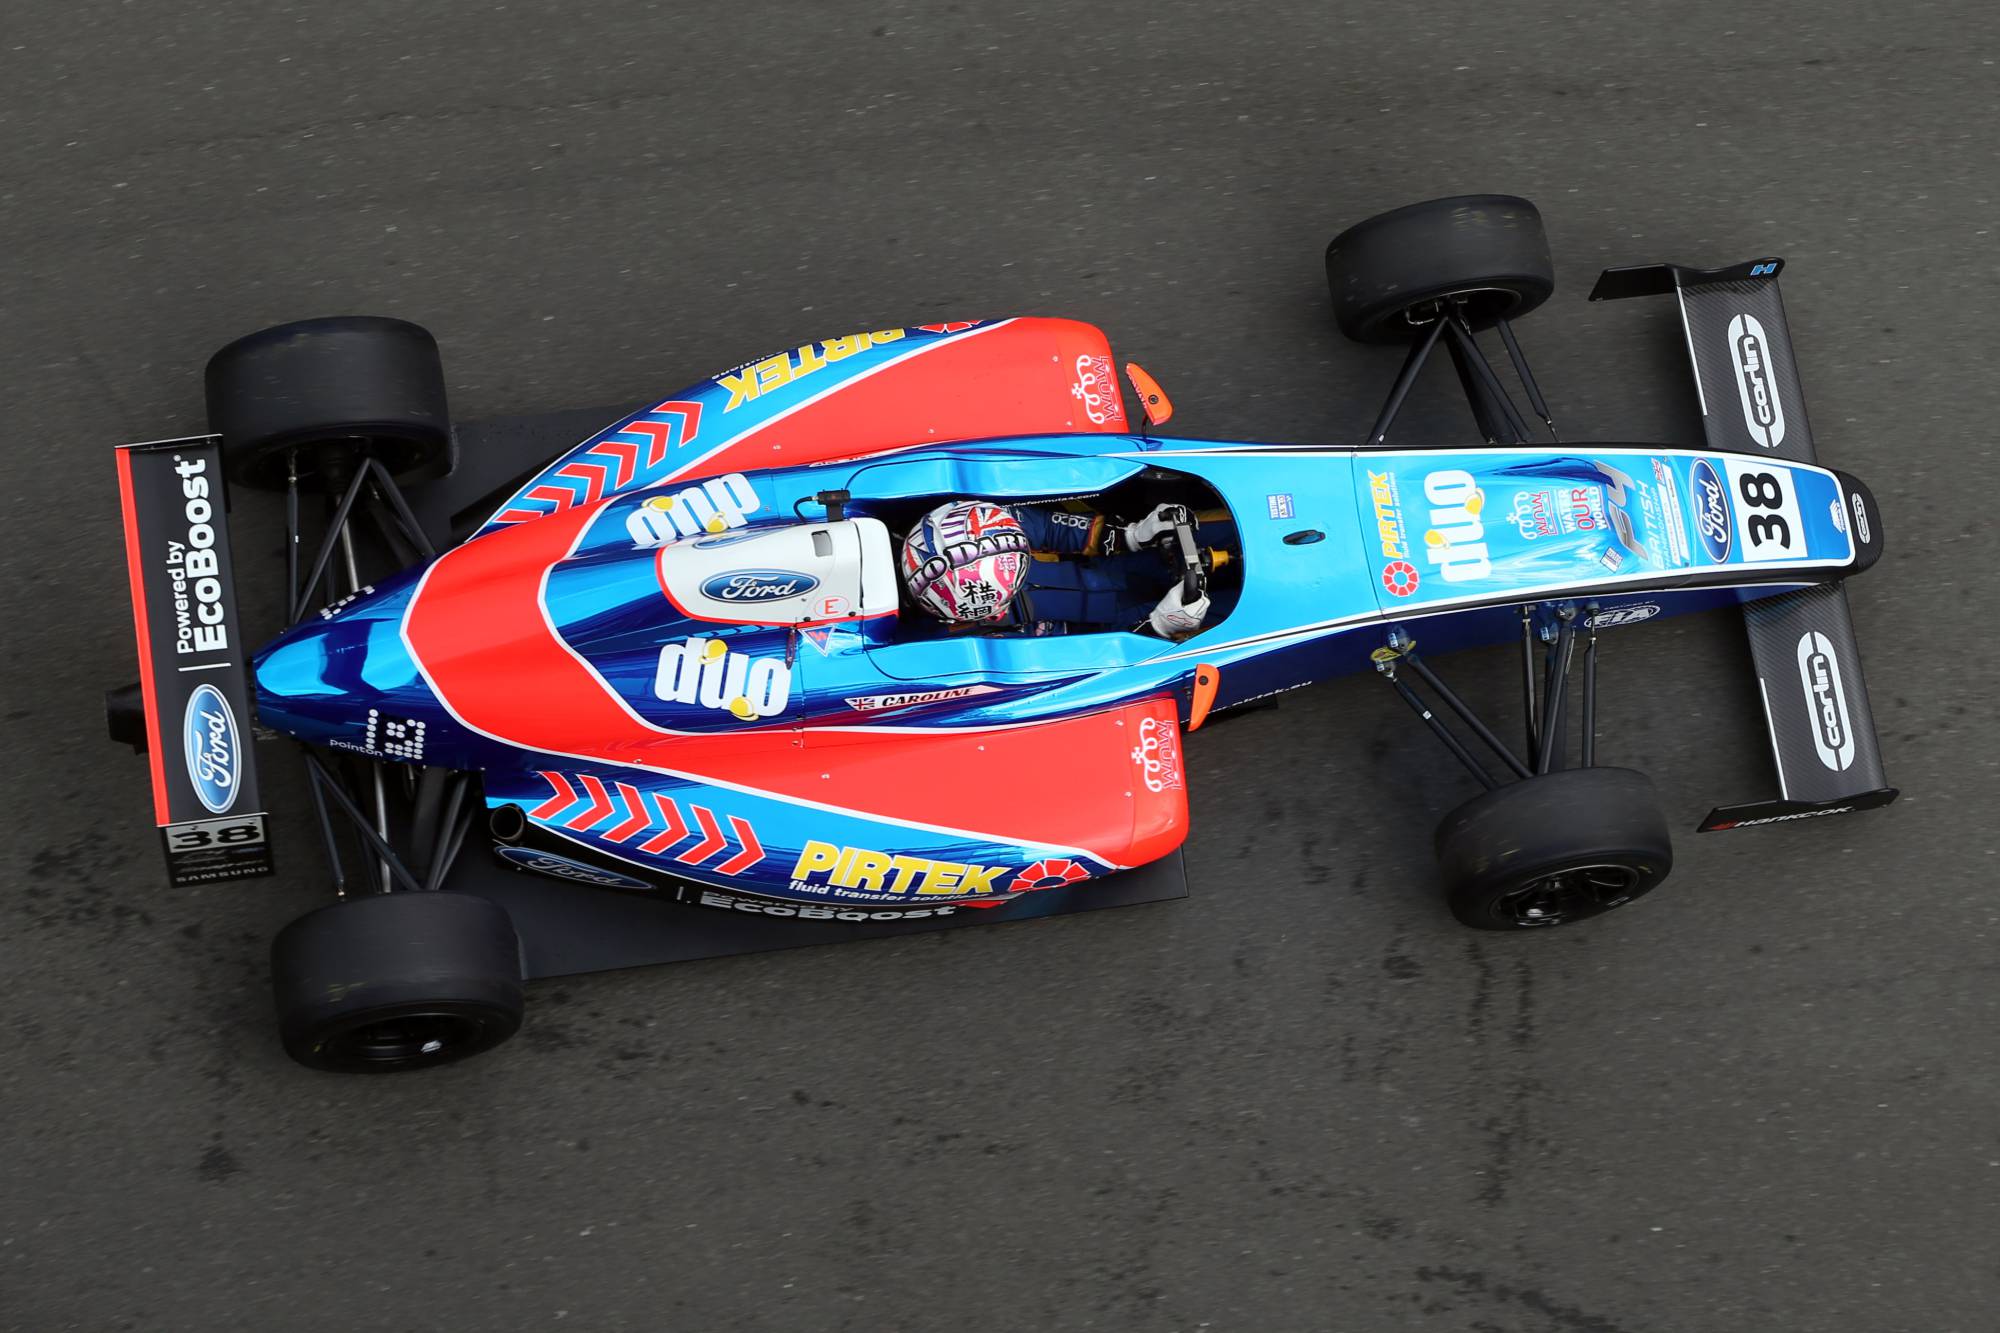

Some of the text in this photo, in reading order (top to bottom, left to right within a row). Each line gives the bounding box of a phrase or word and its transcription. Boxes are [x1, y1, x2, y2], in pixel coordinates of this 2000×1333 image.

[1367, 470, 1402, 559] PIRTEK
[1571, 488, 1595, 531] OUR
[1697, 478, 1728, 544] Ford
[1739, 472, 1791, 550] 38
[175, 458, 228, 652] EcoBoost
[166, 541, 194, 654] Powered by
[720, 576, 800, 599] Ford
[824, 598, 840, 615] E
[881, 687, 976, 708] CAROLINE
[1812, 655, 1841, 747] carlin
[195, 710, 231, 788] Ford
[329, 738, 383, 757] pointon
[173, 824, 262, 852] 38
[175, 865, 269, 883] SAMSUNG
[788, 880, 830, 896] fluid
[834, 887, 907, 902] transfer
[790, 839, 1014, 896] PIRTEK
